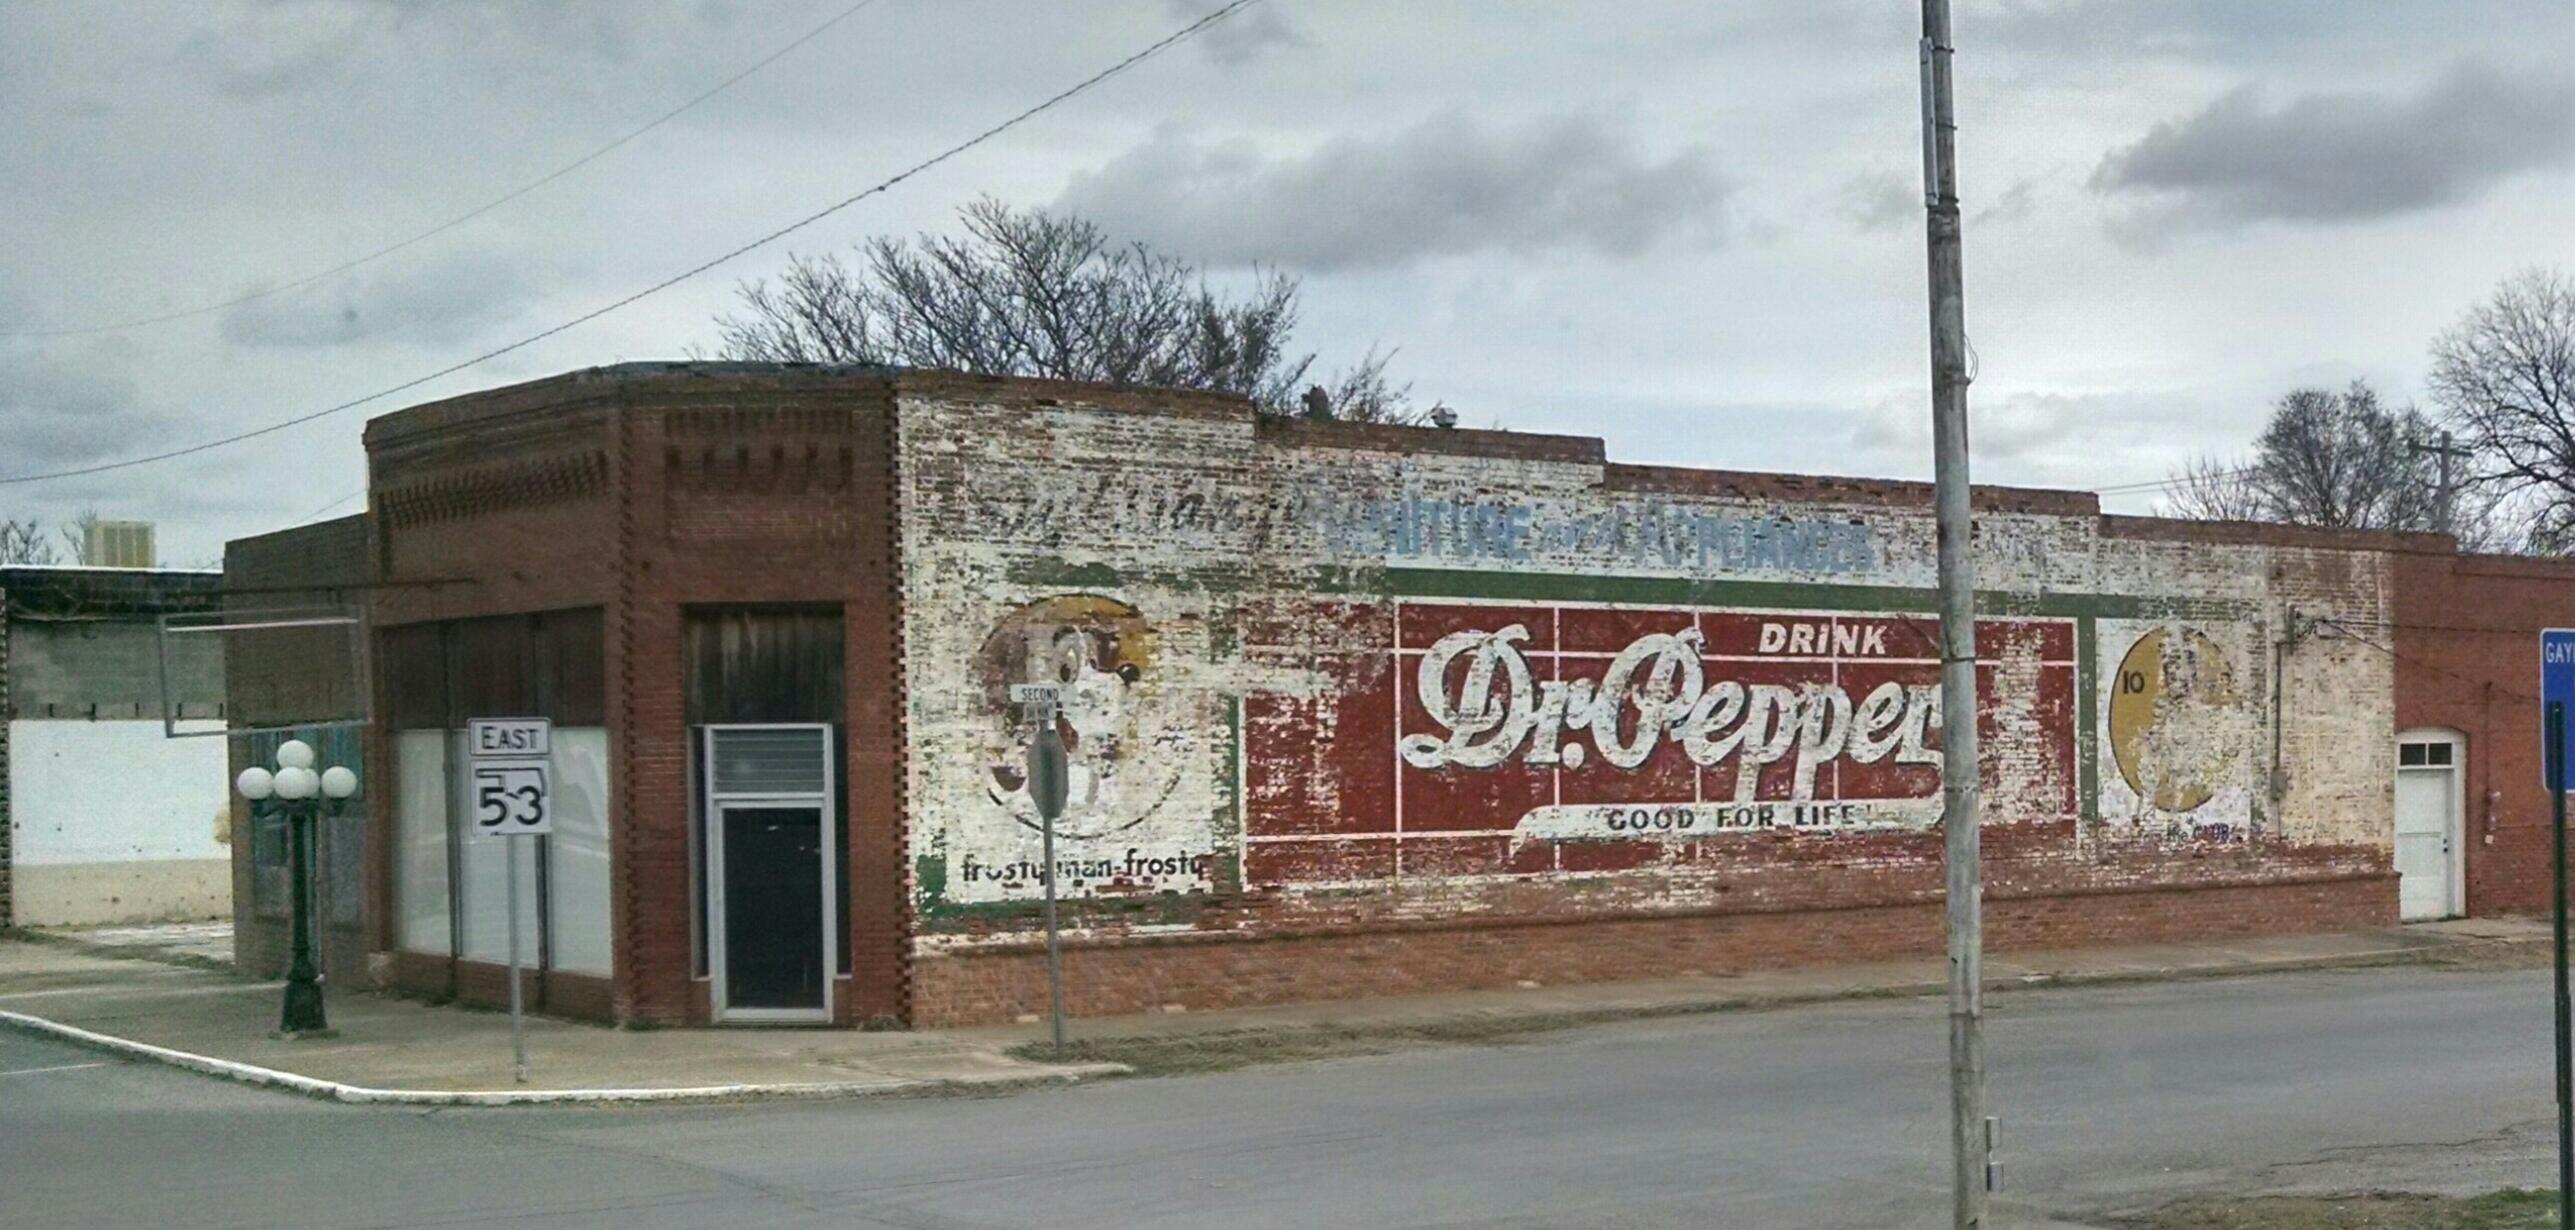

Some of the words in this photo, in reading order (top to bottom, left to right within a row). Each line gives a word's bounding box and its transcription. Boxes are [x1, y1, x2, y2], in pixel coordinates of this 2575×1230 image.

[1758, 622, 1890, 656] DRINK
[2545, 641, 2575, 664] GAY
[1021, 687, 1060, 701] SECOND
[2122, 670, 2146, 694] 10
[1399, 623, 1588, 769] Dr.
[1591, 626, 1945, 803] Pepper
[481, 725, 540, 749] EAST
[479, 785, 543, 827] 53
[1606, 808, 1696, 829] GOOD
[1716, 806, 1776, 828] FOR
